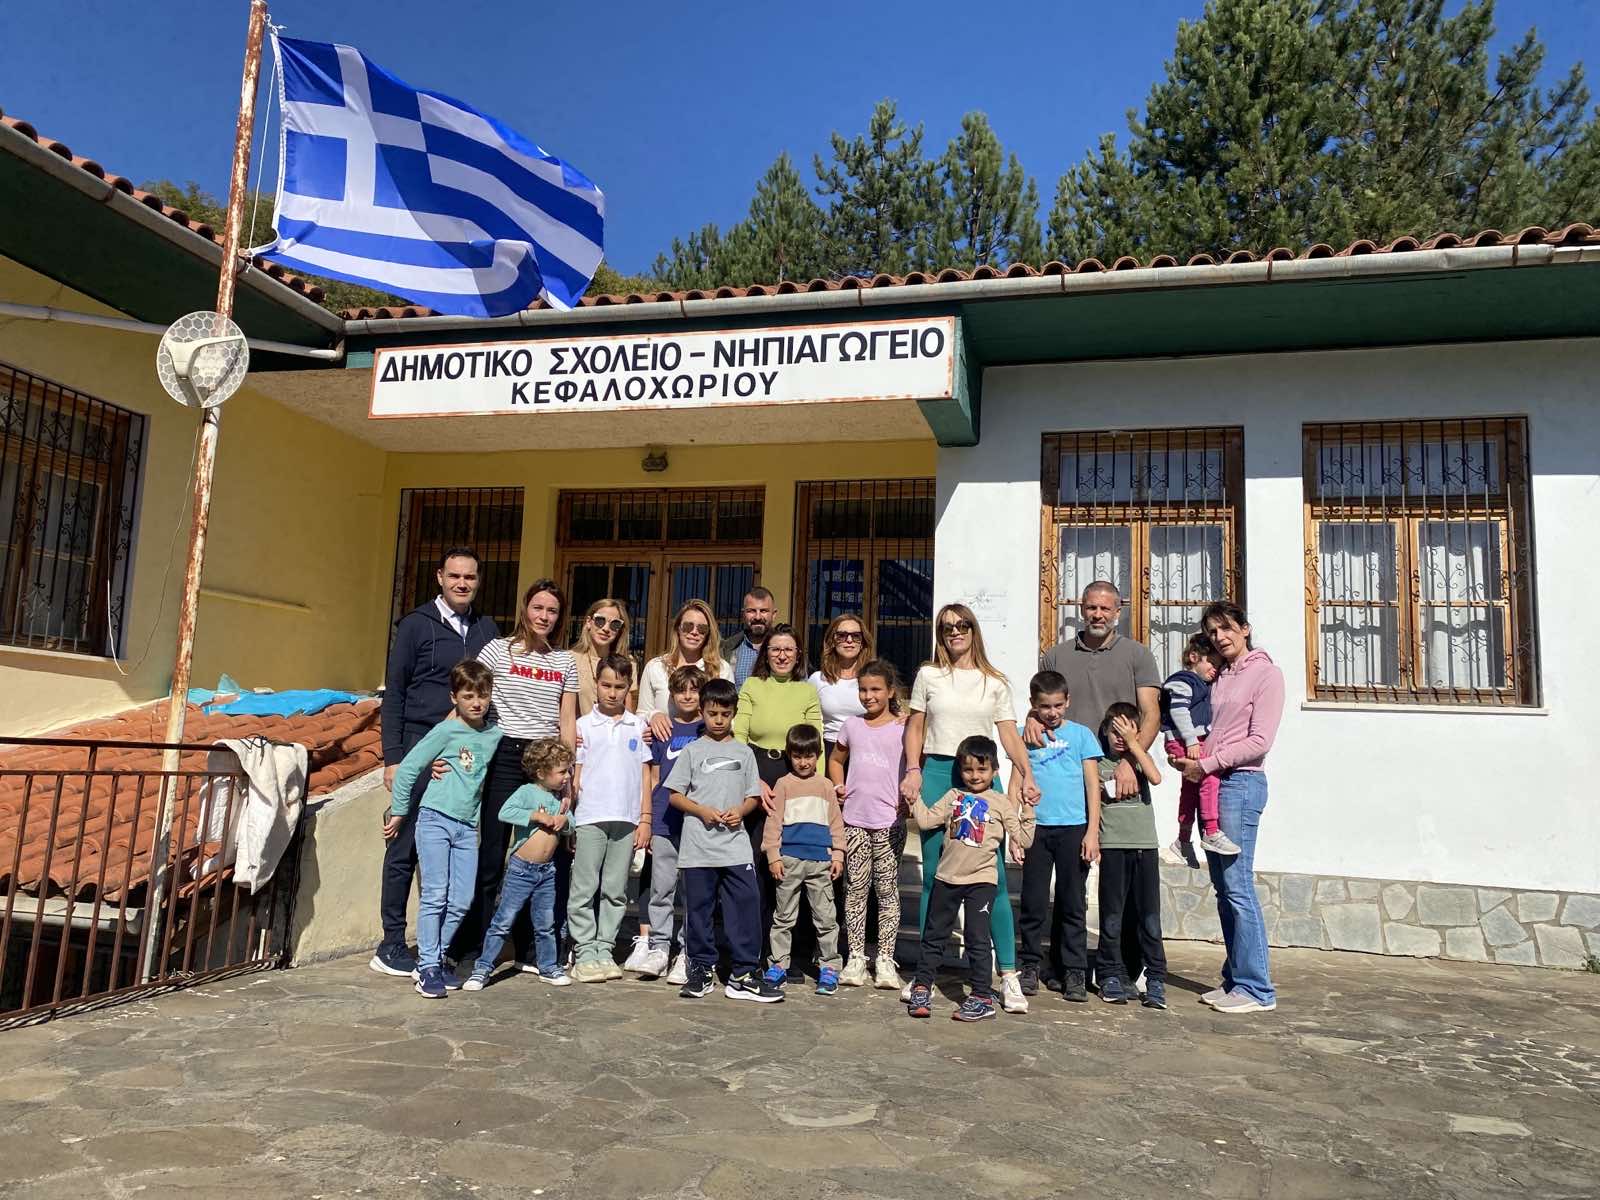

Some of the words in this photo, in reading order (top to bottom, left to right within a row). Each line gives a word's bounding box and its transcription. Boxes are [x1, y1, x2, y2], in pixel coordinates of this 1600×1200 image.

[379, 349, 533, 383] ΔΗΜΟΤΙΚΟ
[549, 342, 682, 376] ΣΧΟΛΕΙΟ
[713, 327, 945, 368] ΝΗΠΙΑΓΩΓΕΙΟ
[511, 371, 779, 405] ΚΕΦΑΛΟΧΩΡΙΟΥ
